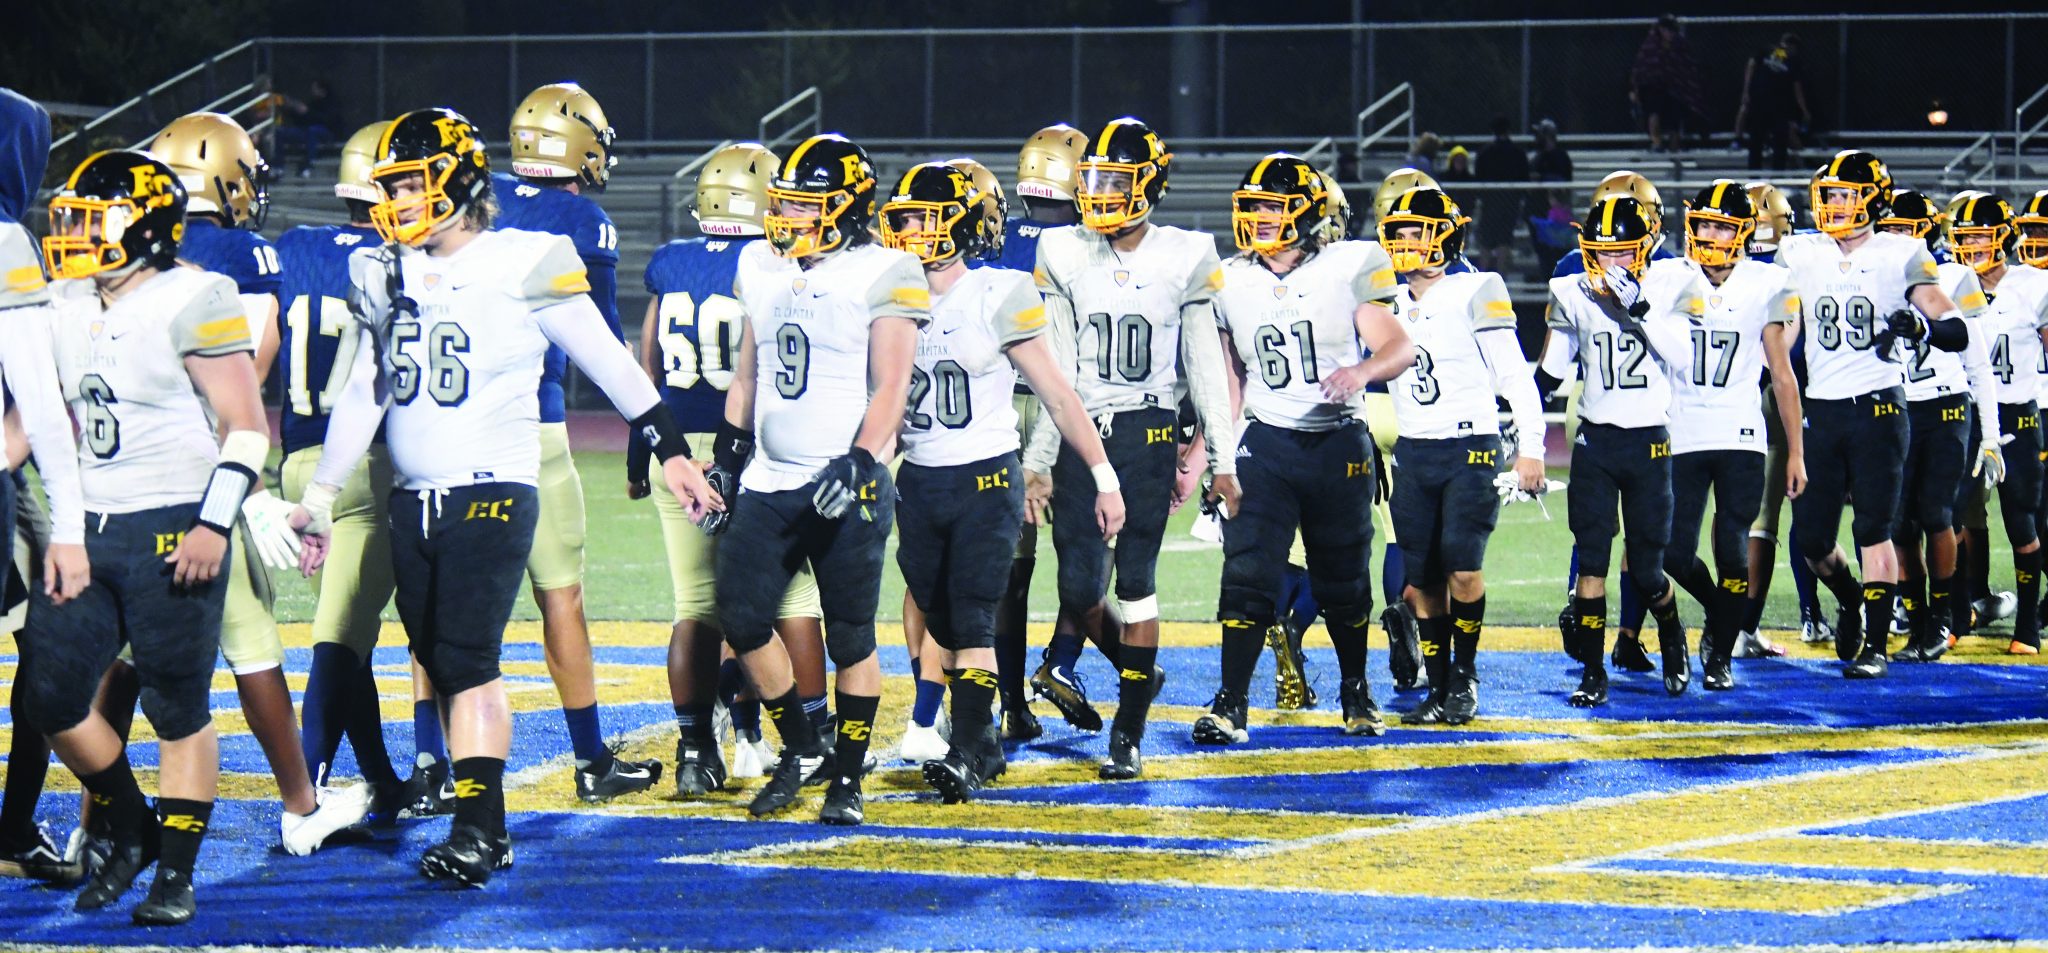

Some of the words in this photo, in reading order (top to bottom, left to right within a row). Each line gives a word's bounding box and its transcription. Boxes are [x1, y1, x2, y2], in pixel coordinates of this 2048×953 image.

[514, 164, 553, 177] Riddell
[1019, 185, 1053, 199] Riddell
[702, 223, 742, 234] Riddell
[253, 246, 280, 275] 10
[774, 306, 783, 318] EL
[784, 307, 815, 319] CAPITAN
[1270, 308, 1300, 320] CAPITAN
[1815, 296, 1874, 351] 89
[658, 292, 744, 391] 60
[917, 344, 949, 357] CAPITAN
[1089, 313, 1153, 382] 10
[286, 294, 361, 416] 17
[389, 322, 471, 407] 56
[776, 323, 811, 400] 9
[1254, 320, 1320, 390] 61
[1593, 330, 1648, 390] 12
[1690, 330, 1740, 388] 17
[1903, 337, 1937, 383] 2
[1990, 333, 2014, 385] 4
[1410, 345, 1441, 406] 3
[905, 360, 973, 430] 20
[79, 373, 121, 460] 6
[1941, 404, 1966, 422] EC
[2017, 412, 2039, 430] EC
[1145, 424, 1173, 446] EC
[1466, 448, 1497, 468] EC
[859, 479, 877, 501] C
[975, 466, 1009, 492] EC
[464, 498, 513, 522] EC
[1722, 578, 1748, 593] EC
[1581, 615, 1605, 629] EC
[957, 669, 999, 688] EC
[840, 719, 871, 742] EC
